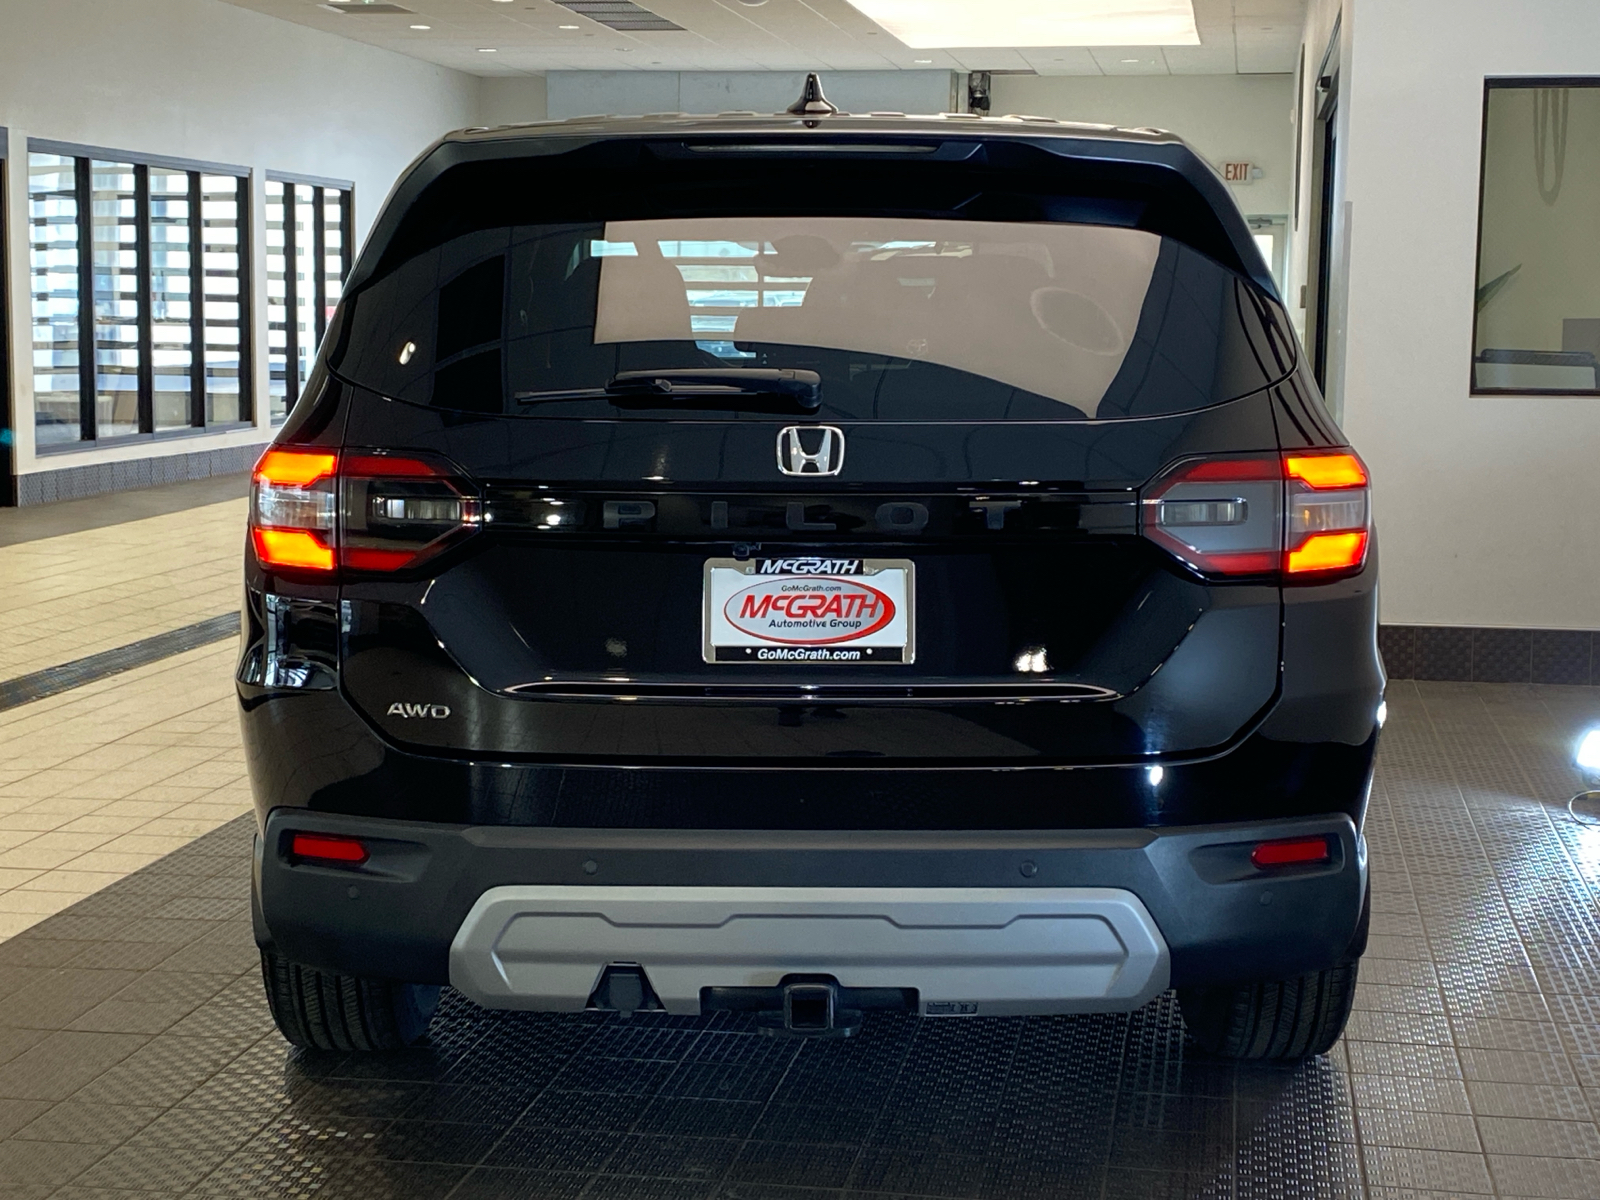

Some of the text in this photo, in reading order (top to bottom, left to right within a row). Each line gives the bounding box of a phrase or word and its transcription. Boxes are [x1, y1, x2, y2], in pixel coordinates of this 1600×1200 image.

[1225, 163, 1249, 181] EXIT
[603, 501, 1021, 530] PILOT
[781, 584, 841, 592] GoMcGrath.com
[768, 618, 862, 630] Automotive Group
[757, 649, 860, 660] GoMcGrath.com
[387, 702, 451, 719] AWD
